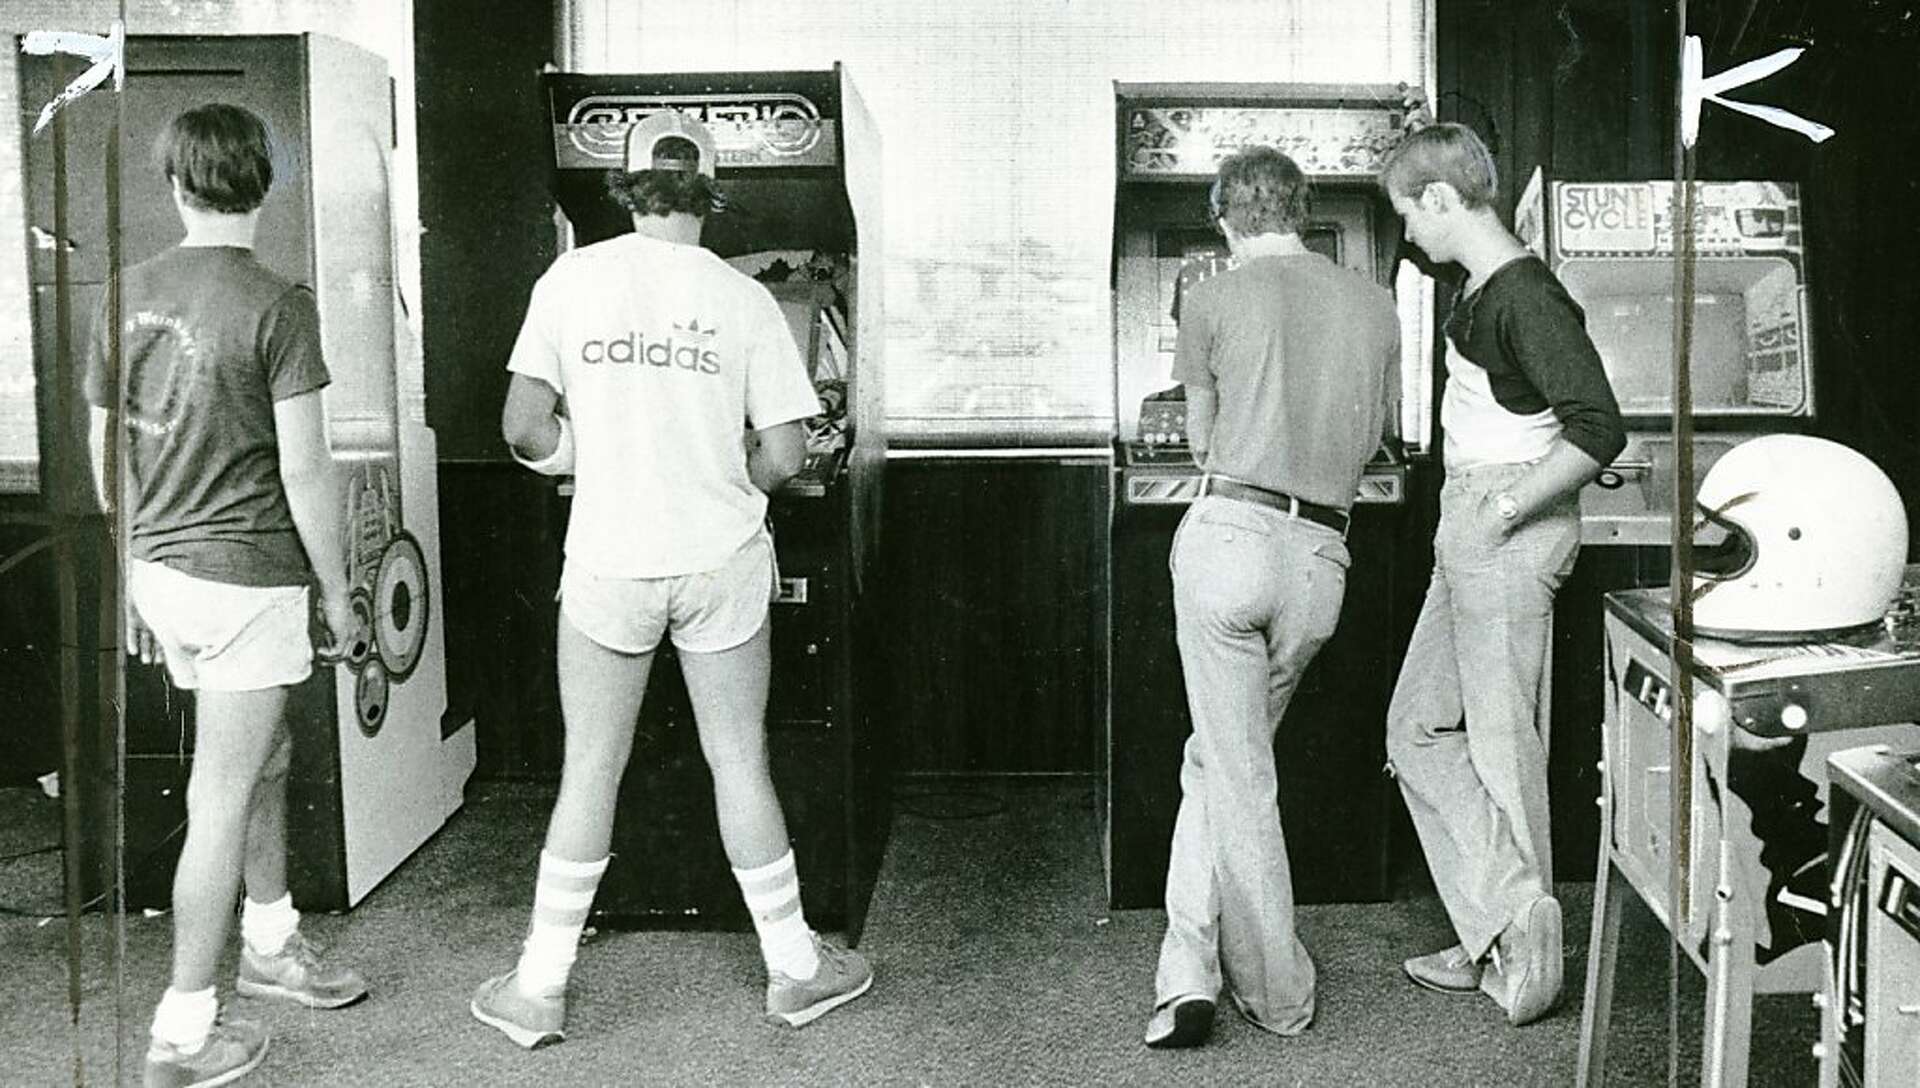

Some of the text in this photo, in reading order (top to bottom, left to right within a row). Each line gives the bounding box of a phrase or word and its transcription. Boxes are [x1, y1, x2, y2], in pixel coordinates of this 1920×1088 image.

[1566, 186, 1646, 208] STUNT
[1564, 208, 1648, 230] CYCLE
[581, 331, 721, 375] adidas
